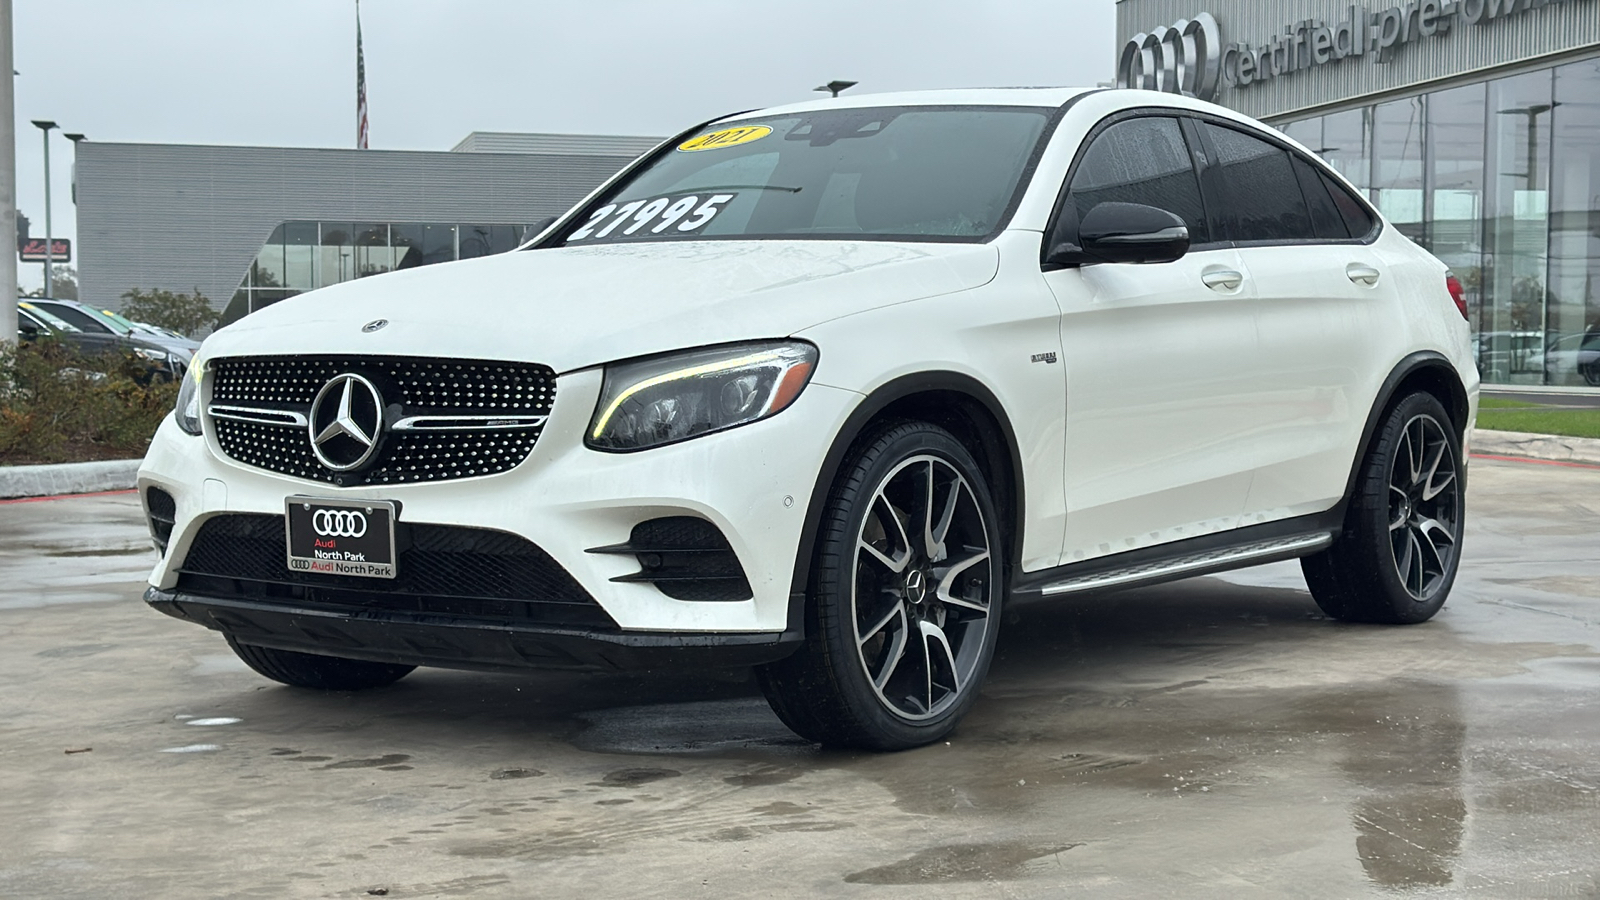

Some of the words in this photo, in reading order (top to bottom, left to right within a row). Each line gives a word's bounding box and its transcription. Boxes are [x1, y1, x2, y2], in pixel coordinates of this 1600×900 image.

[1222, 4, 1366, 88] Certified
[686, 127, 760, 149] 2021
[566, 194, 734, 242] 27995
[314, 538, 336, 548] Audi
[314, 549, 342, 560] North
[344, 551, 365, 562] Park
[311, 561, 334, 571] Audi
[336, 563, 366, 574] North
[368, 565, 391, 576] Park
